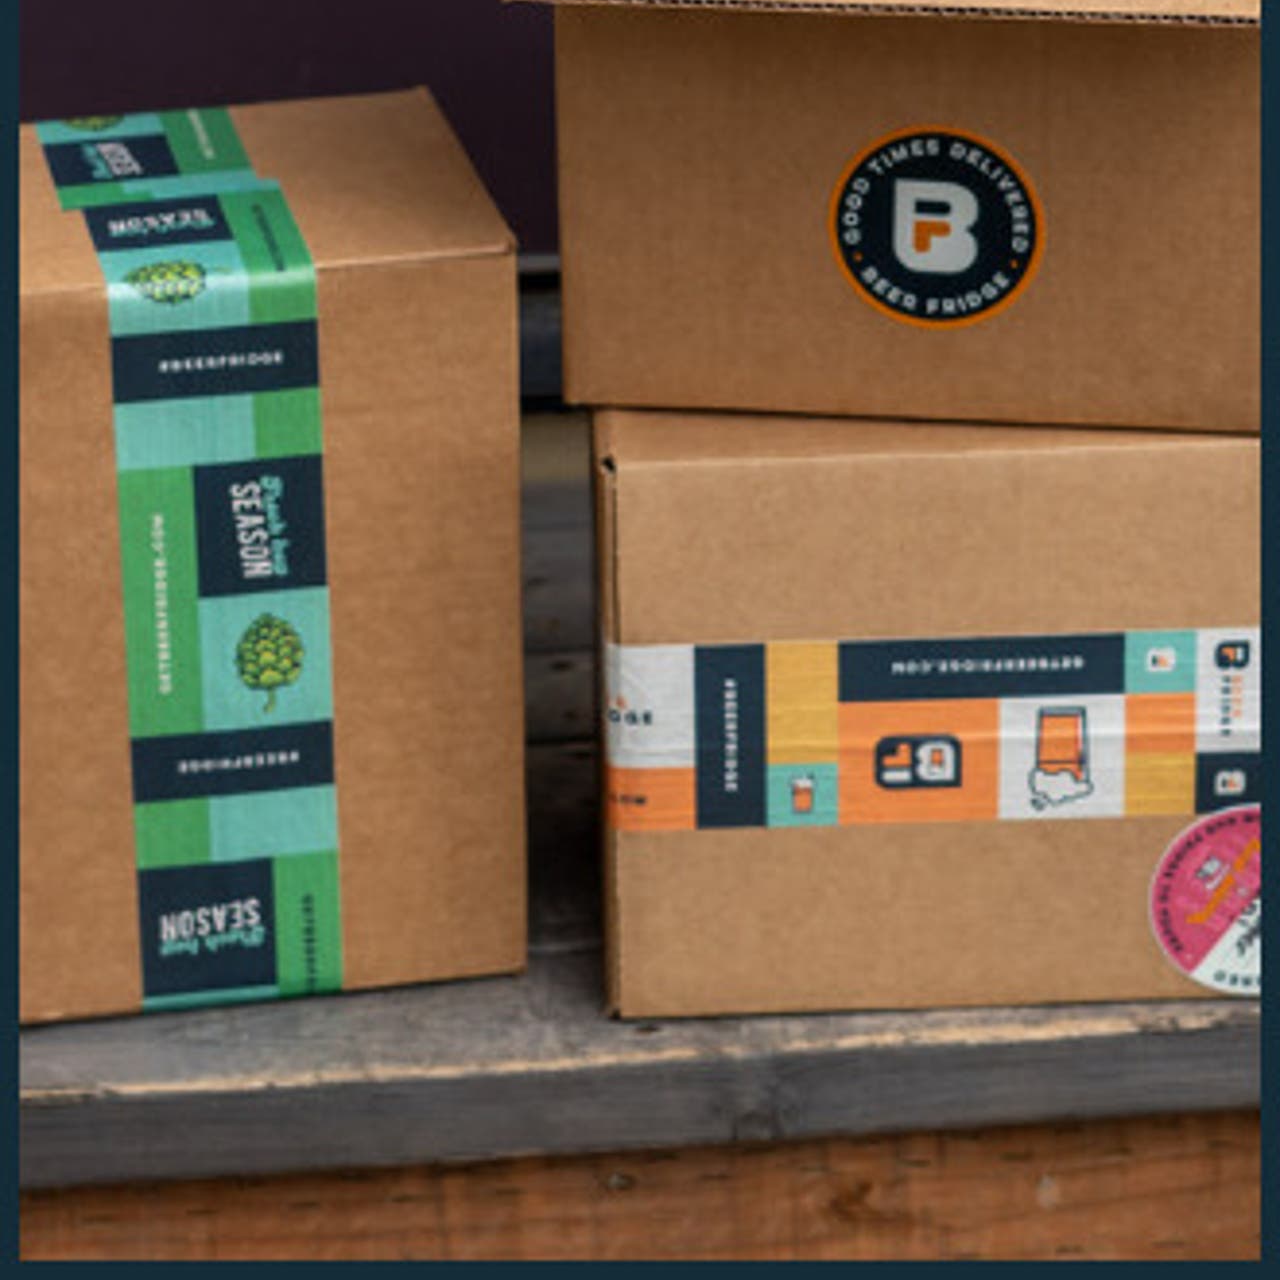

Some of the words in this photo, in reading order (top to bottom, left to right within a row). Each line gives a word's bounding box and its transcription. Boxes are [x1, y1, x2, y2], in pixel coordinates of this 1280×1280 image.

[841, 177, 870, 245] GOOD
[868, 139, 940, 175] TIMES
[949, 141, 1030, 253] DELIVERED
[862, 266, 918, 310] BEER
[925, 272, 1010, 315] FRIDGE
[229, 481, 272, 578] SEASON
[159, 898, 262, 942] SEASON
